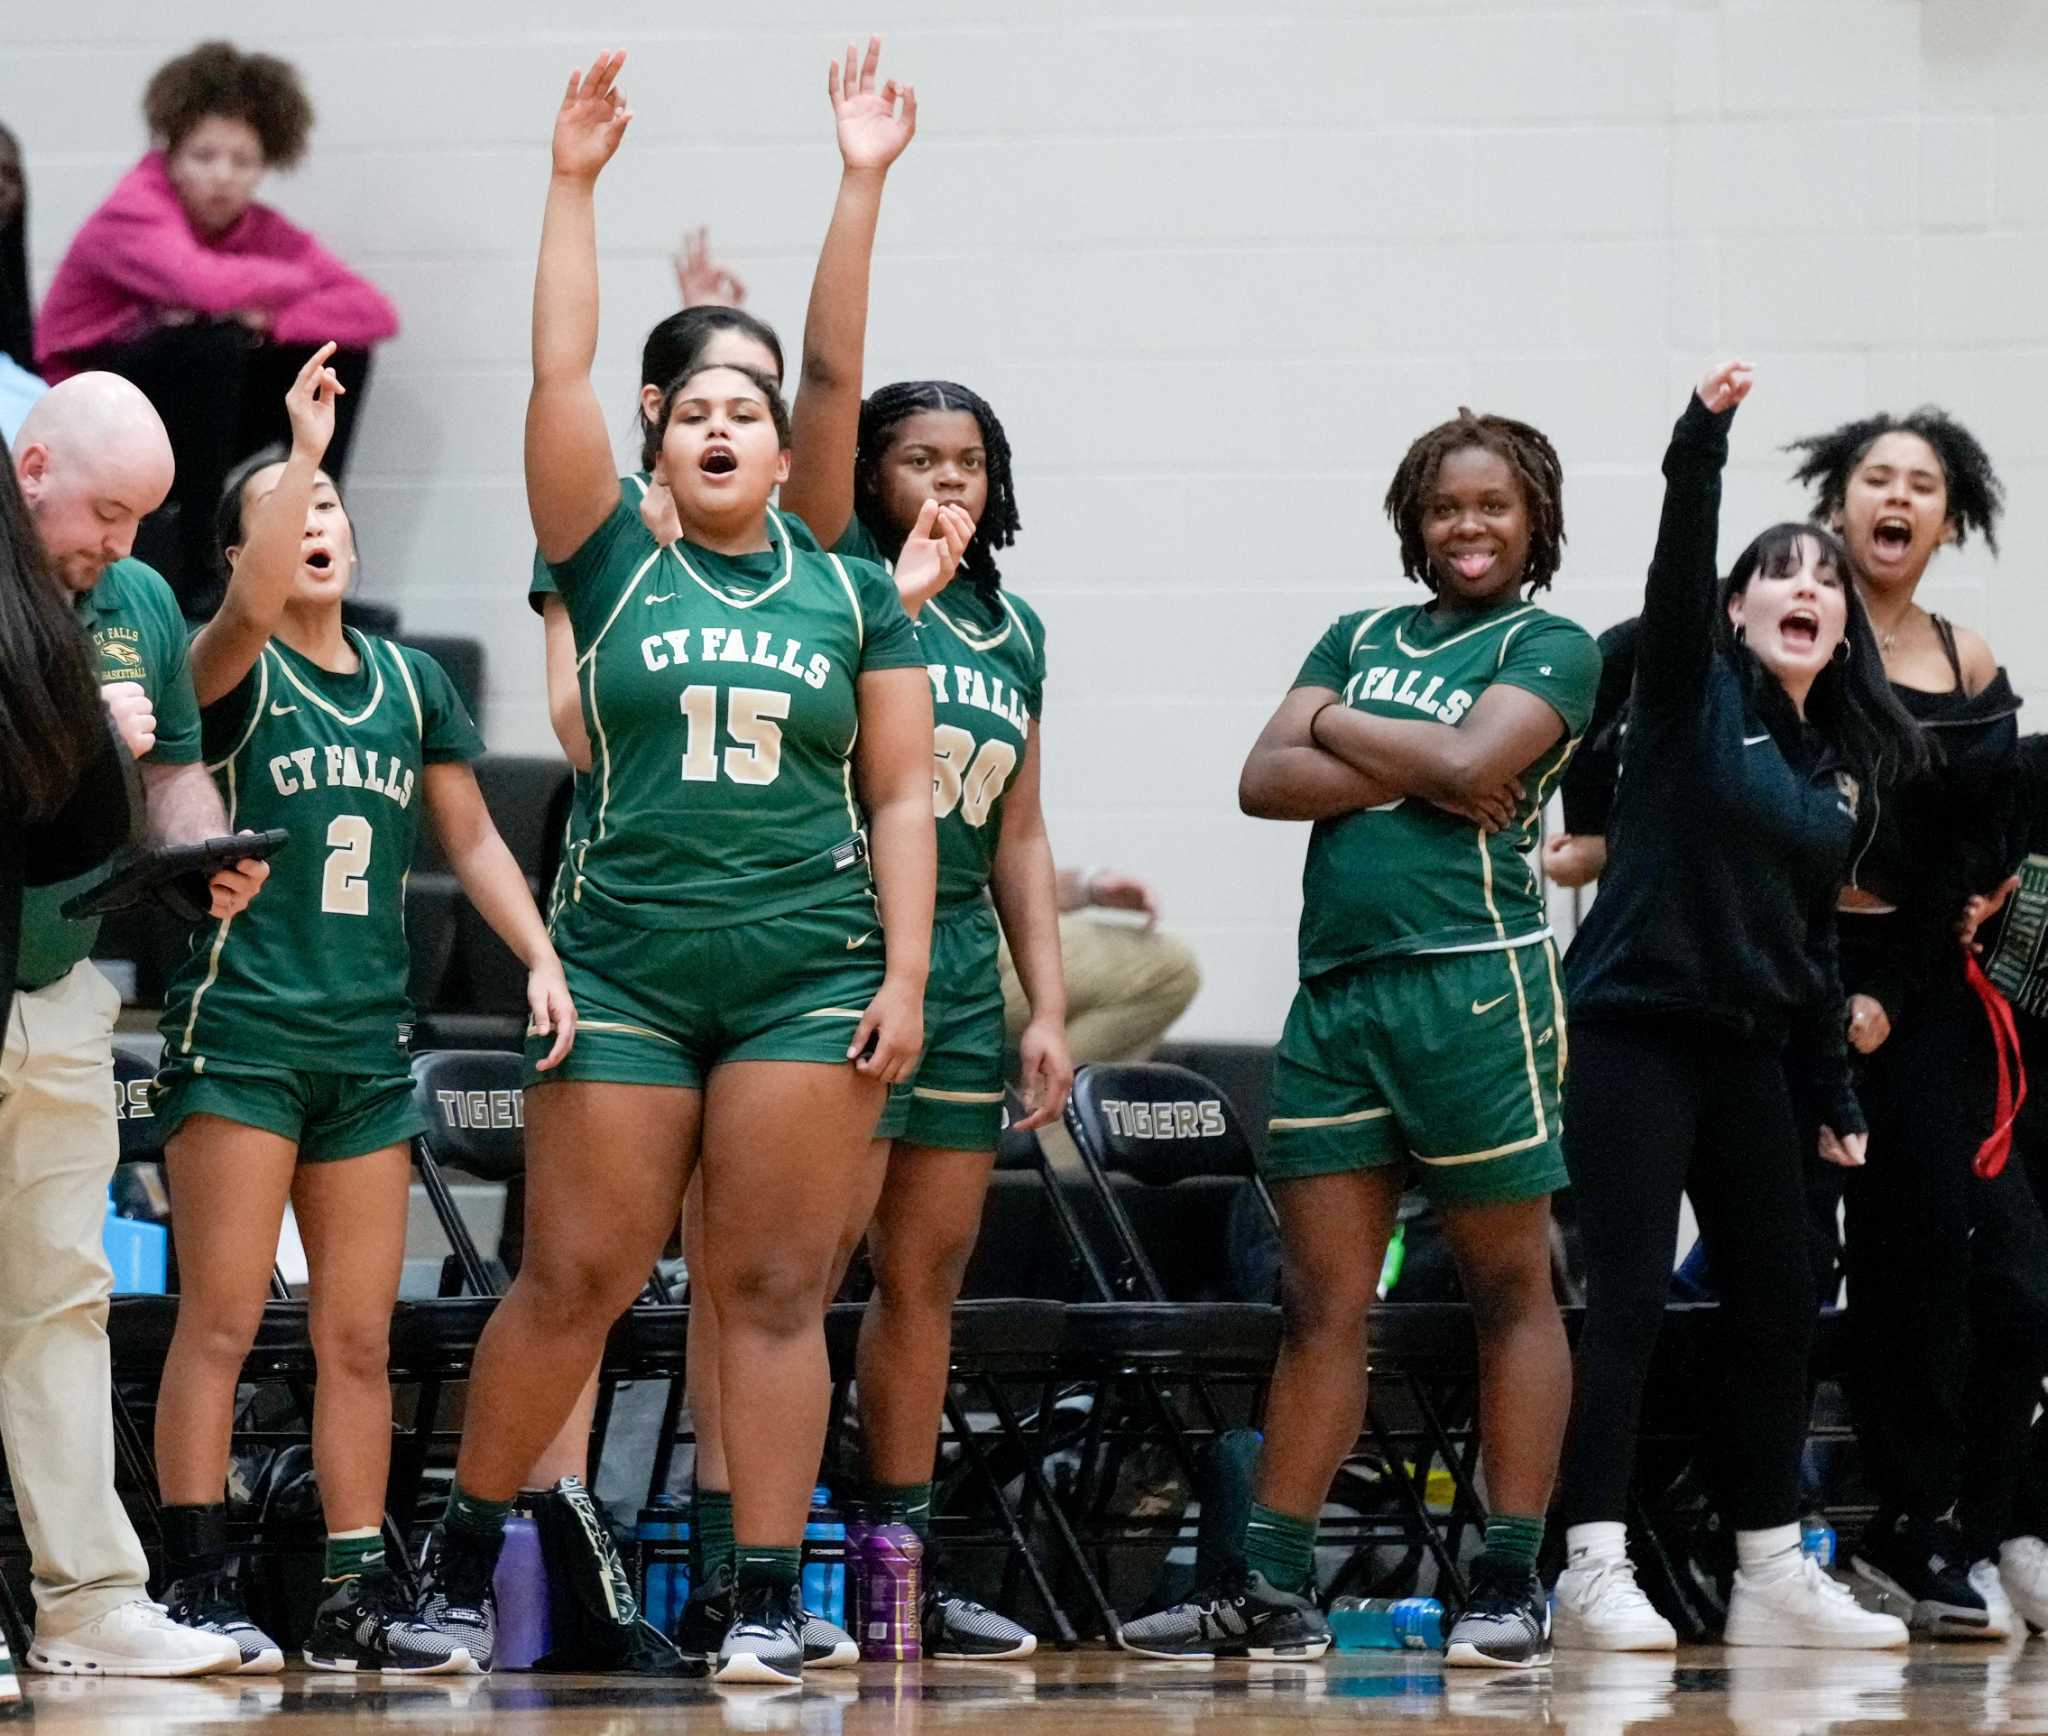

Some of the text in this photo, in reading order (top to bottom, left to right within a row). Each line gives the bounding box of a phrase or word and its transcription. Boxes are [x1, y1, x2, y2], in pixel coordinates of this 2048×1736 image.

[93, 627, 139, 645] CY FALLS
[640, 627, 831, 689] CY FALLS
[1359, 666, 1473, 725] FALLS
[680, 684, 791, 786] 15
[269, 744, 415, 809] CY FALLS
[933, 723, 1017, 829] 30
[321, 814, 373, 916] 2
[436, 1090, 525, 1128] TIGE
[1101, 1100, 1226, 1139] TIGERS
